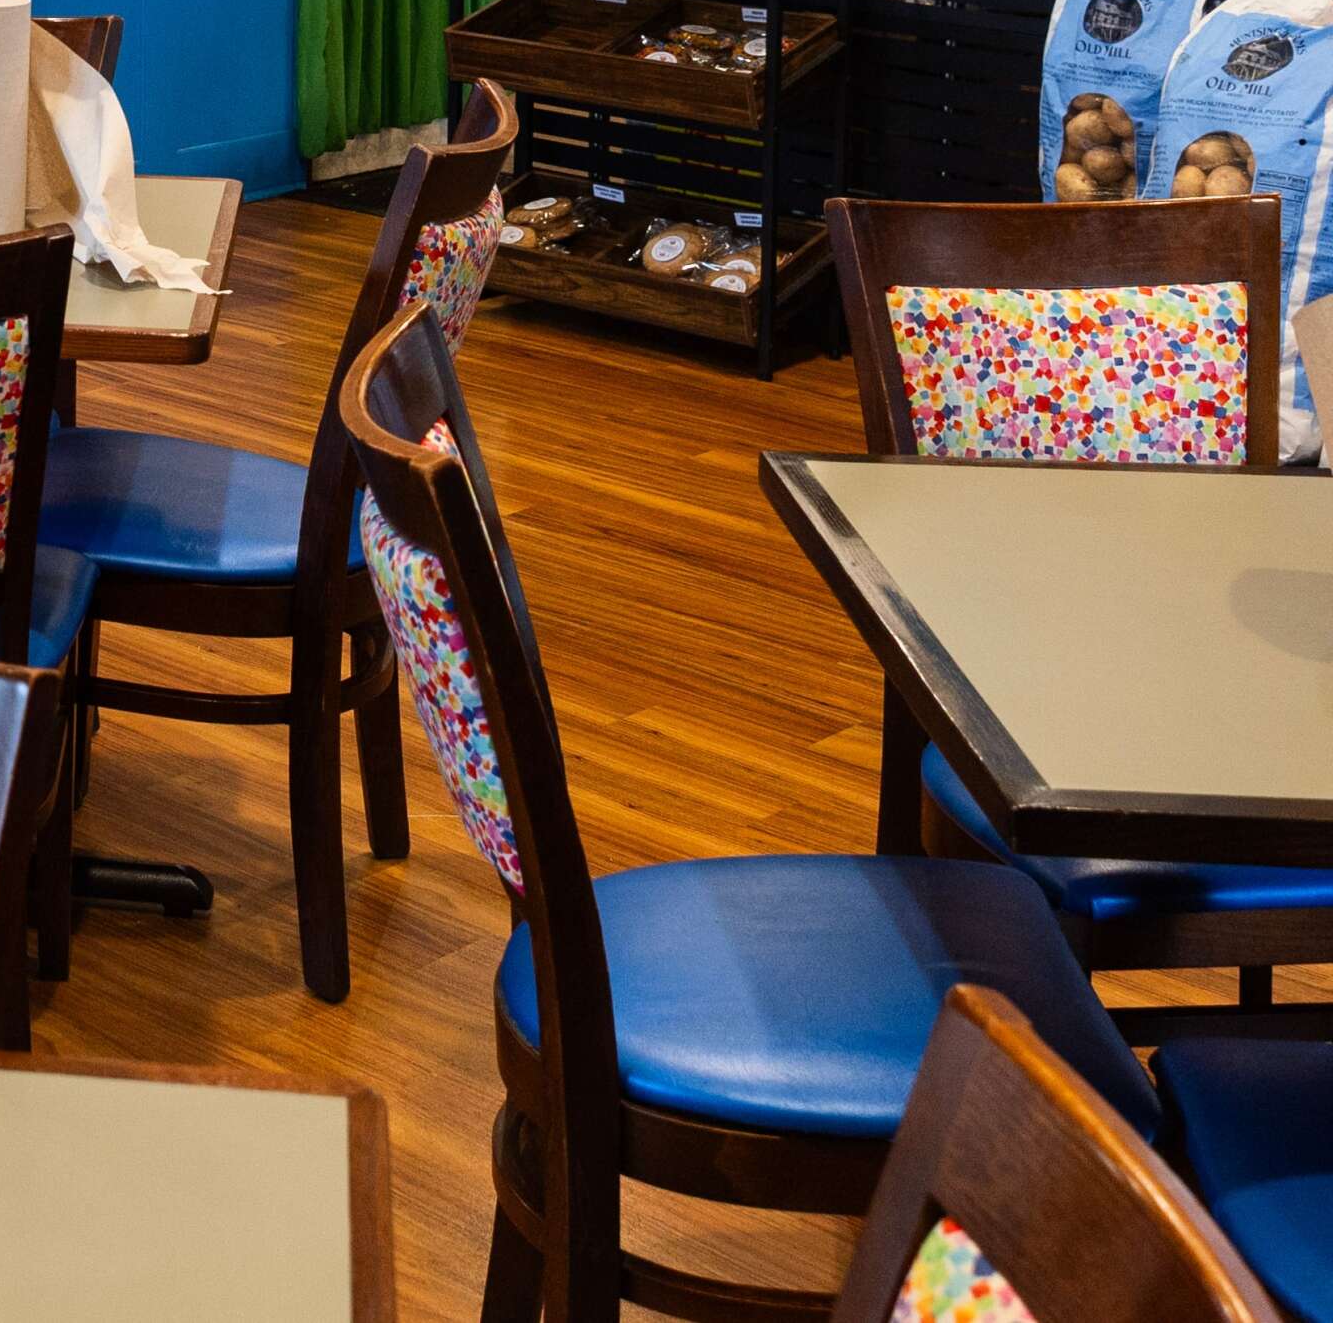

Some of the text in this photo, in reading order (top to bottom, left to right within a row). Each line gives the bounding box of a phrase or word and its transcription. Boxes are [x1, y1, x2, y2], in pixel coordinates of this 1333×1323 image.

[1075, 39, 1133, 60] OLD MILL
[1205, 77, 1274, 98] OLD MILL
